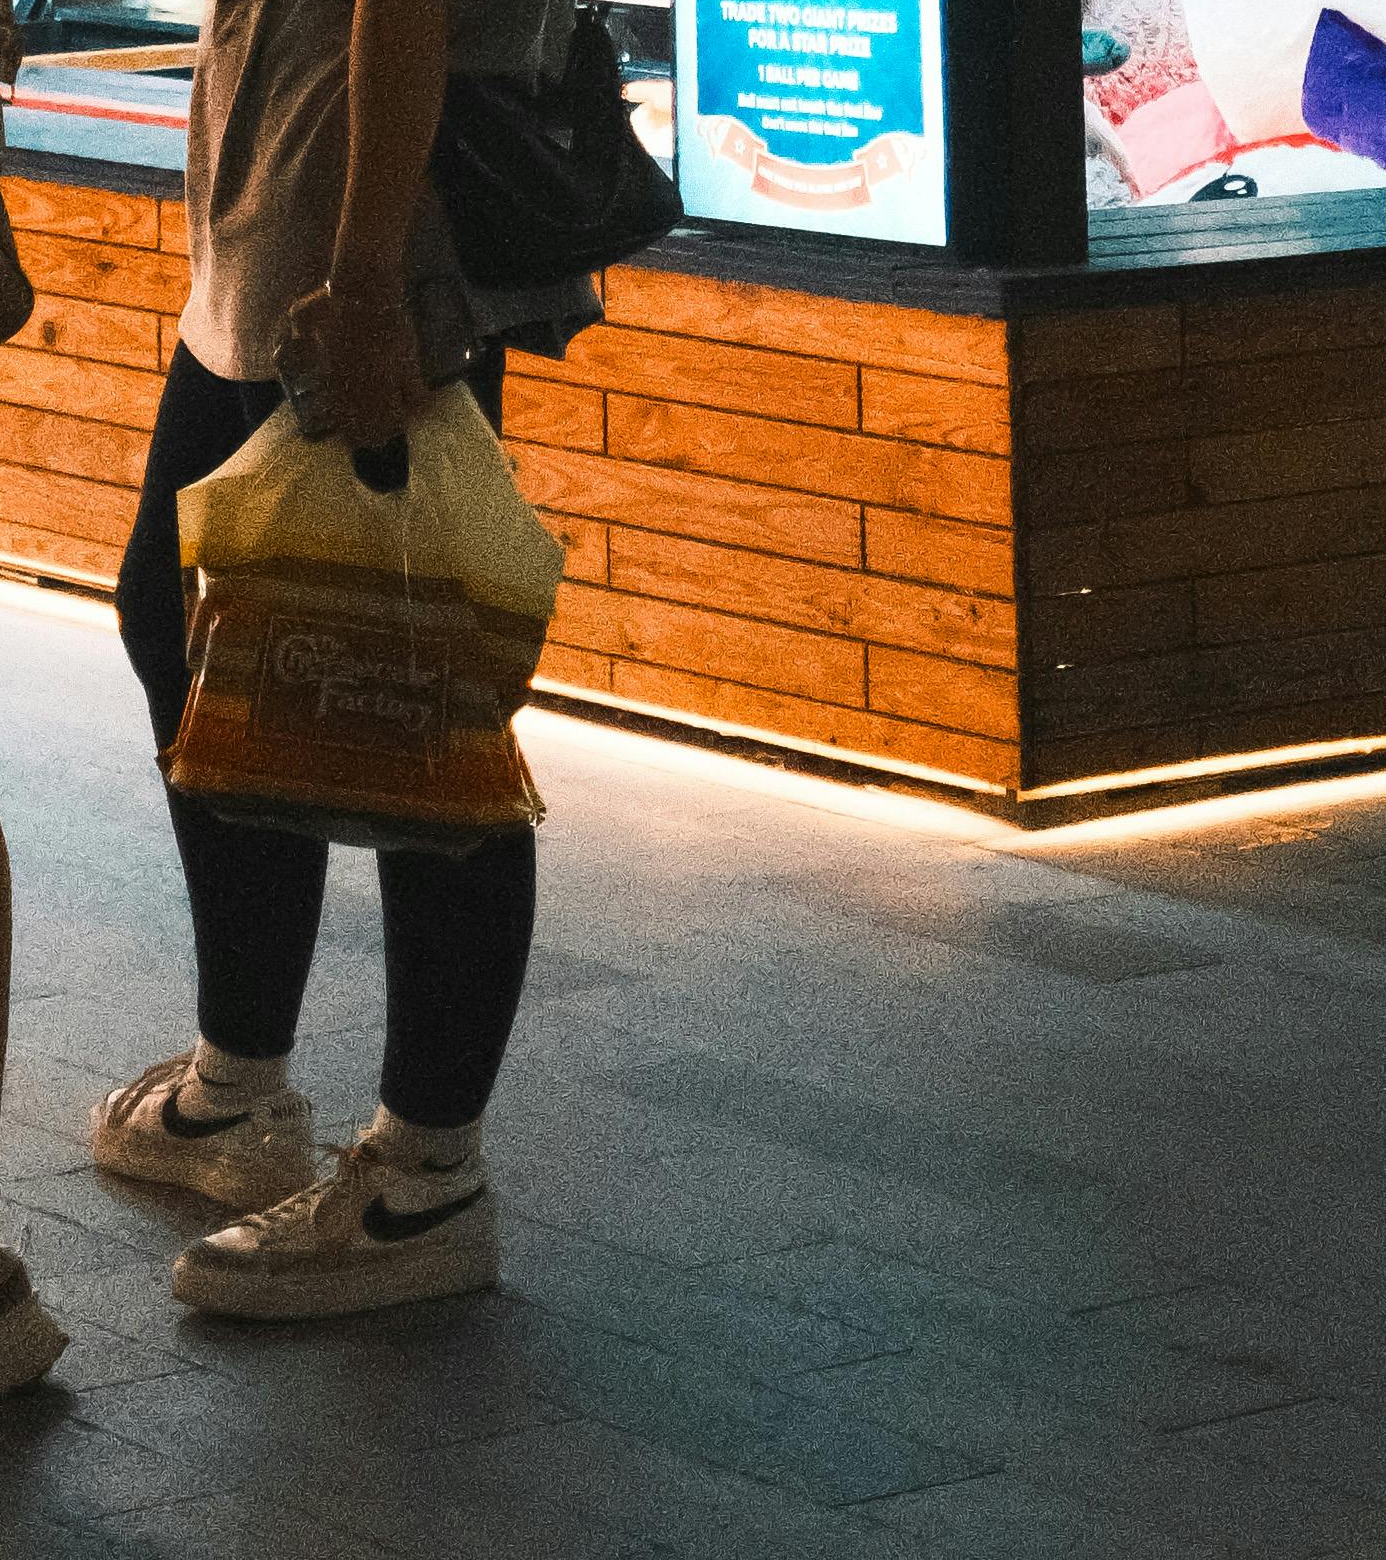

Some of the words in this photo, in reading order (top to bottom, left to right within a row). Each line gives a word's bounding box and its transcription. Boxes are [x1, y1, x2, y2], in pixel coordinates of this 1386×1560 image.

[720, 0, 766, 24] TRADE
[768, 3, 800, 26] TWO
[802, 5, 846, 31] GIANT
[847, 9, 898, 34] PRIZES
[748, 26, 776, 51] FOR
[778, 30, 791, 52] A
[791, 30, 828, 55] STAR
[829, 34, 872, 58] PRIZE
[822, 69, 859, 91] GAME
